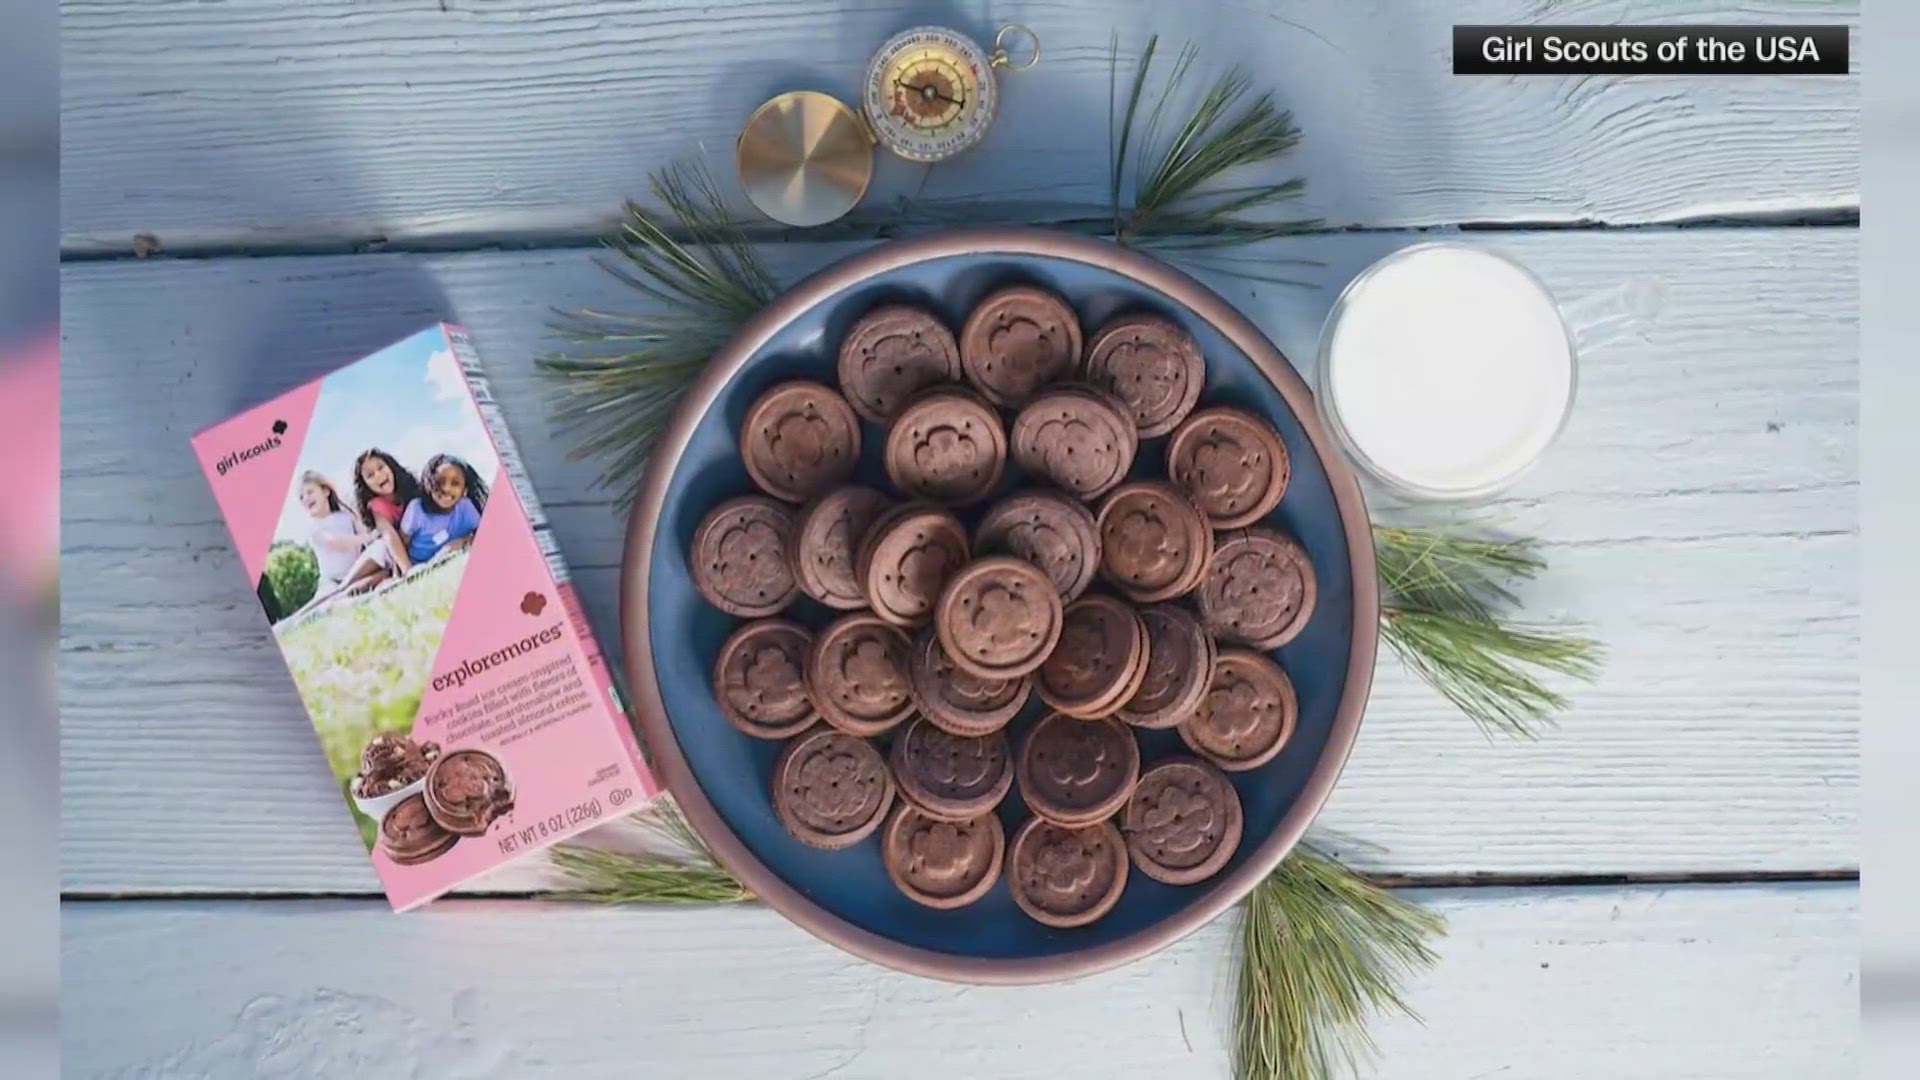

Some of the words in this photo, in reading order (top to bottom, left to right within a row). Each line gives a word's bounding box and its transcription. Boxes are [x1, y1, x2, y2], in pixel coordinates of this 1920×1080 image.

[216, 451, 239, 476] girl
[239, 436, 282, 462] scouts
[446, 708, 484, 731] cookies
[509, 685, 533, 702] with
[566, 664, 578, 678] of
[495, 687, 562, 723] marshmallow
[562, 676, 583, 693] and
[516, 702, 555, 727] almond
[498, 837, 519, 854] NET
[519, 825, 539, 845] WT
[538, 821, 549, 838] 8
[548, 814, 566, 833] OZ
[565, 797, 603, 827] (226g)
